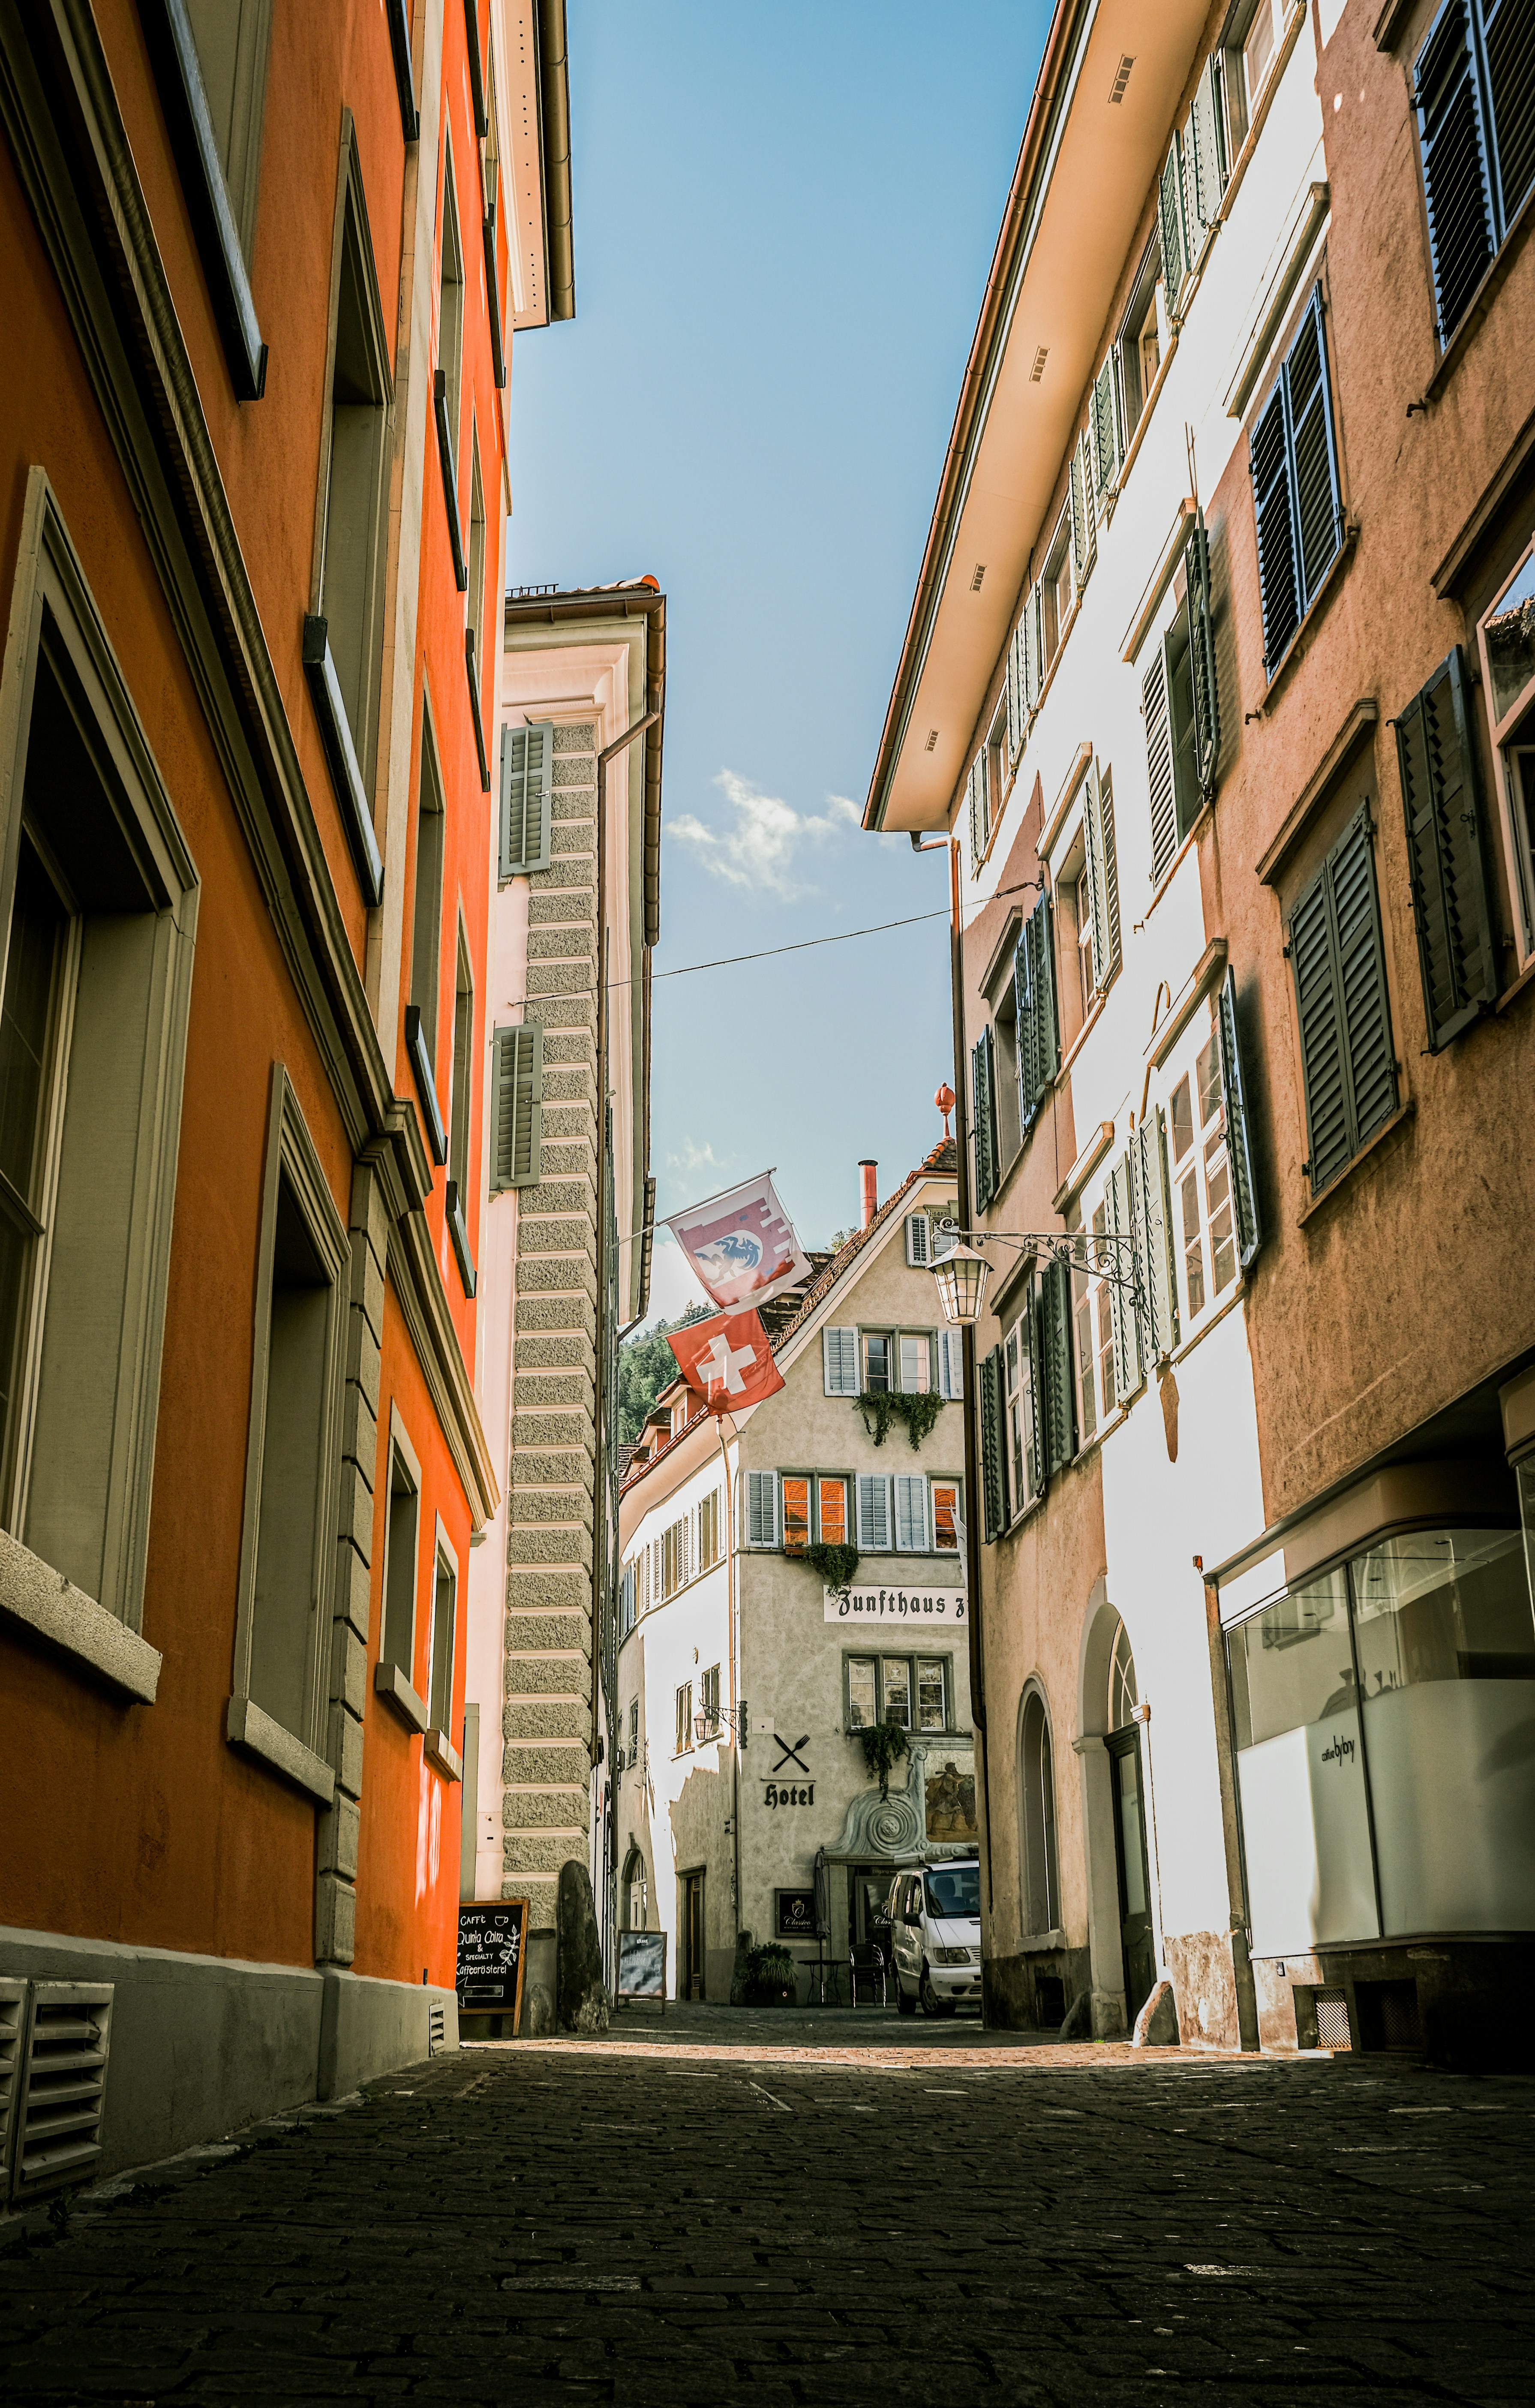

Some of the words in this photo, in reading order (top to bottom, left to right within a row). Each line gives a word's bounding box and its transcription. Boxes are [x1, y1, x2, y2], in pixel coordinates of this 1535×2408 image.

[838, 1590, 945, 1617] Zunfthaus
[764, 1784, 814, 1810] Hotel
[460, 1915, 486, 1926] CAFFÈ
[784, 1915, 811, 1925] Classico
[478, 1944, 483, 1952] &
